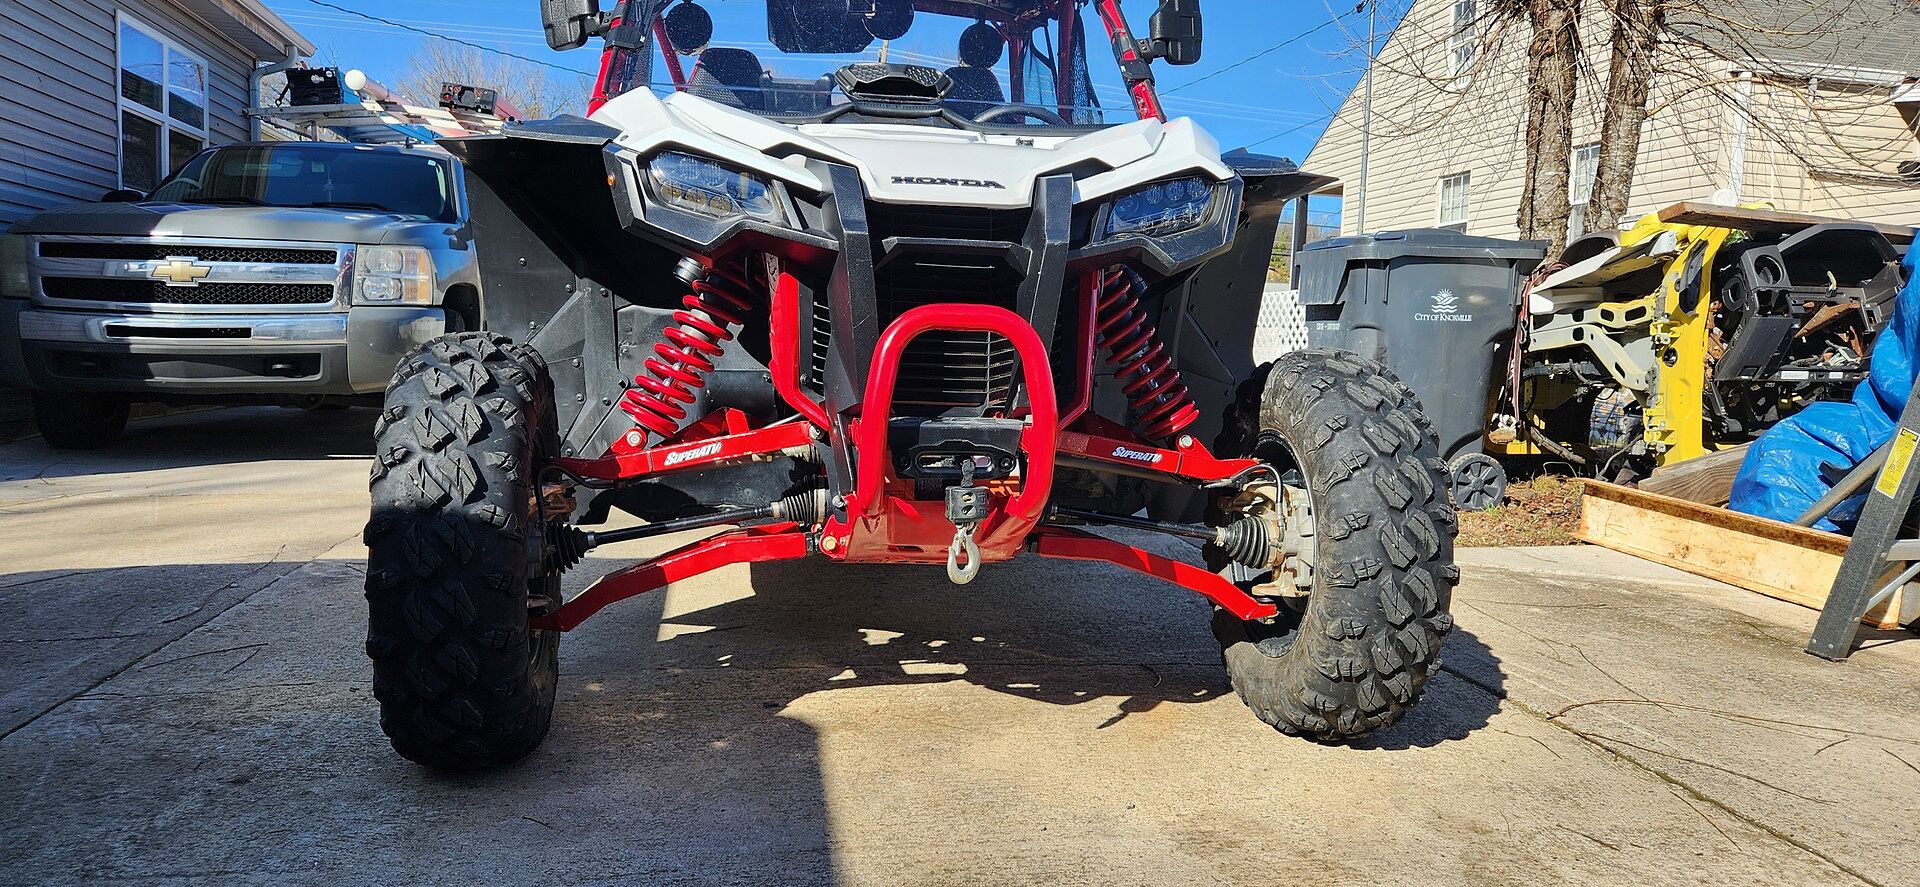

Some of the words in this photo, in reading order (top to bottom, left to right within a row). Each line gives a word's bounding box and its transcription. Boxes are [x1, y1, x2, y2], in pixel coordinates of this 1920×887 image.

[891, 176, 1006, 189] HONDA
[1414, 312, 1431, 321] CITY
[1440, 313, 1472, 322] KNOXVILLE
